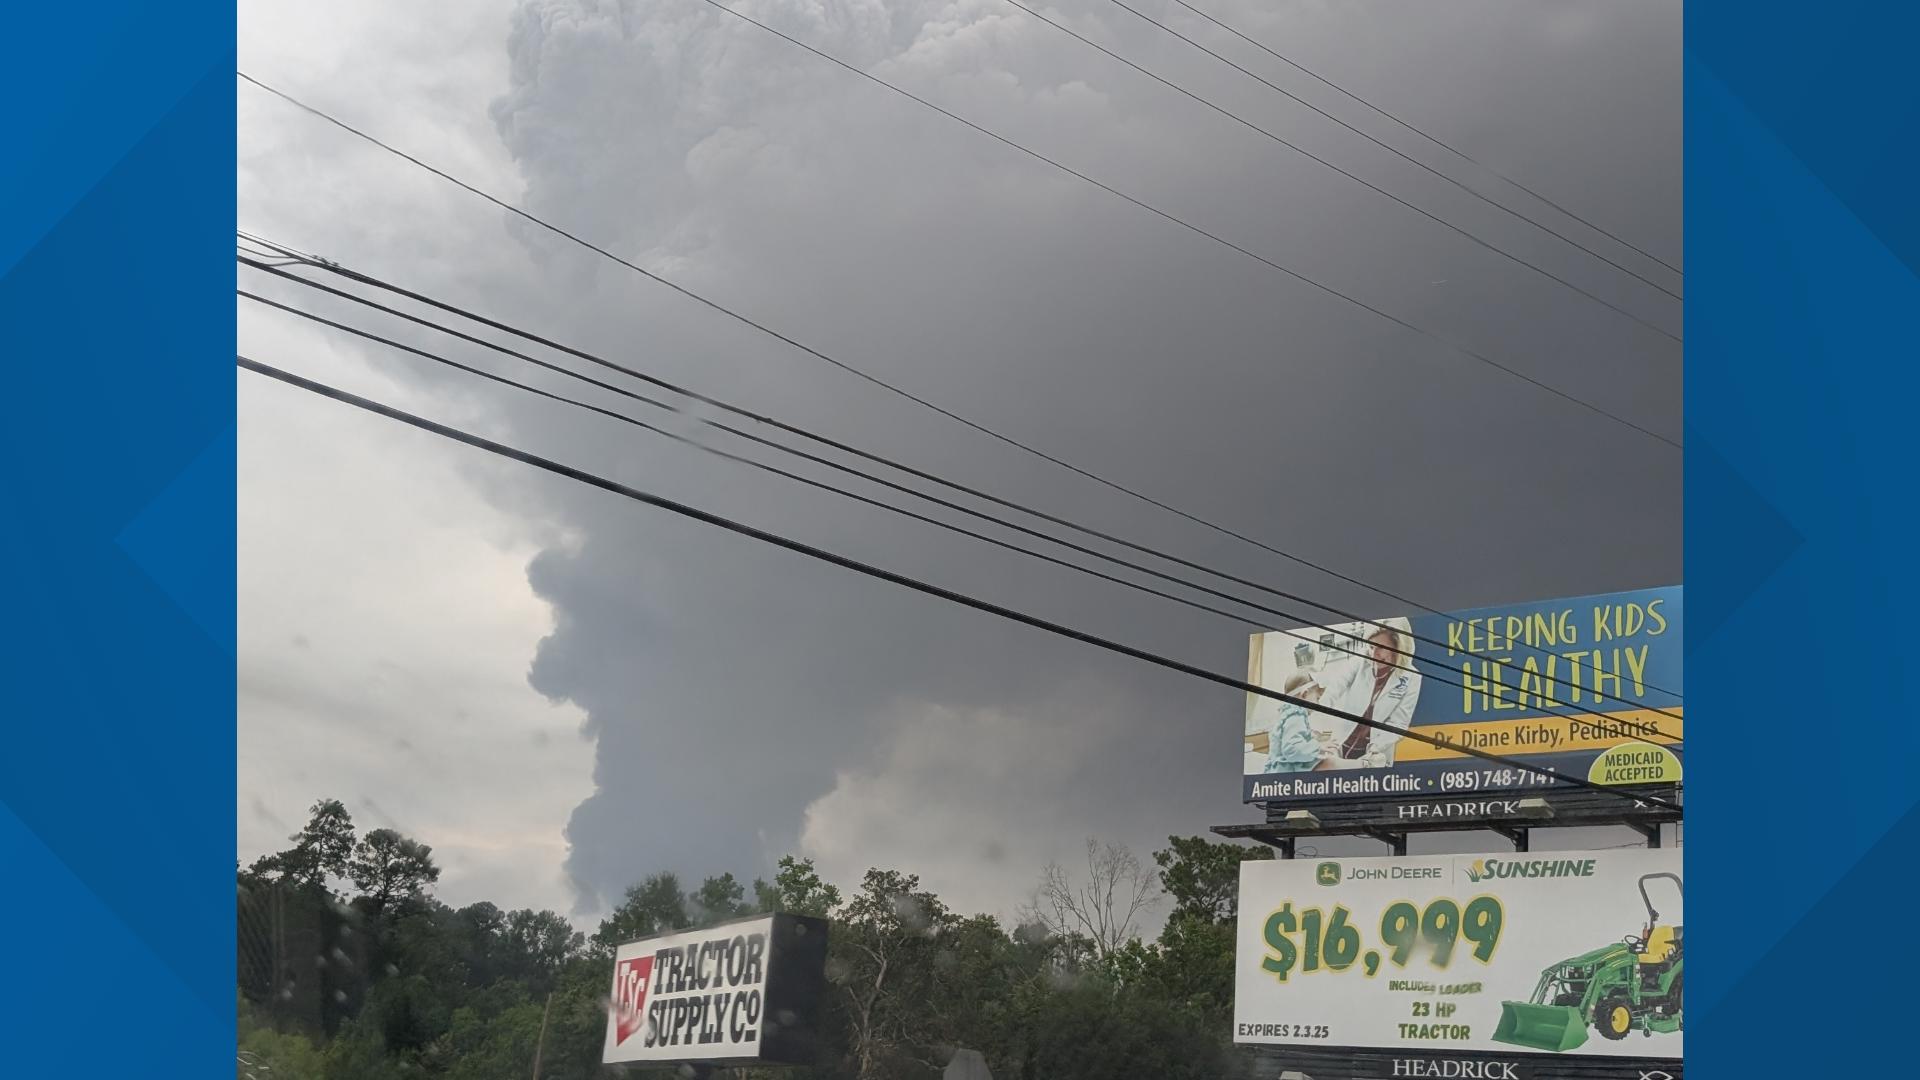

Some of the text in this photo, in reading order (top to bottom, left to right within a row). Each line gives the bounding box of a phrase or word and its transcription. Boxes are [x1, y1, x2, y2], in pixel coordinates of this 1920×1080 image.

[1448, 599, 1667, 656] KEEPING KIDS
[1462, 644, 1648, 714] HEALTHY
[1434, 717, 1659, 750] Dr Diane Kirby, Pediatrics
[1605, 751, 1663, 767] MEDICAID
[1252, 780, 1291, 798] Amite
[1294, 777, 1329, 796] Rural
[1333, 775, 1379, 794] Health
[1382, 773, 1421, 792] Clinic
[1440, 771, 1479, 791] (985)
[1605, 766, 1663, 782] ACCEPTED
[1397, 800, 1520, 819] HEADRICK
[1347, 866, 1442, 880] JOHN DEERE
[1481, 858, 1596, 880] SUNSHINE
[1261, 895, 1504, 982] $16,999
[653, 933, 766, 995] TRACTOR
[619, 961, 648, 1022] TSC
[644, 992, 731, 1048] SUPPLY
[1412, 1001, 1457, 1018] 23 HP
[1238, 1023, 1329, 1038] EXPIRES 2.3.25
[1398, 1023, 1471, 1040] TRACTOR
[1391, 1058, 1520, 1080] HEADRICK
